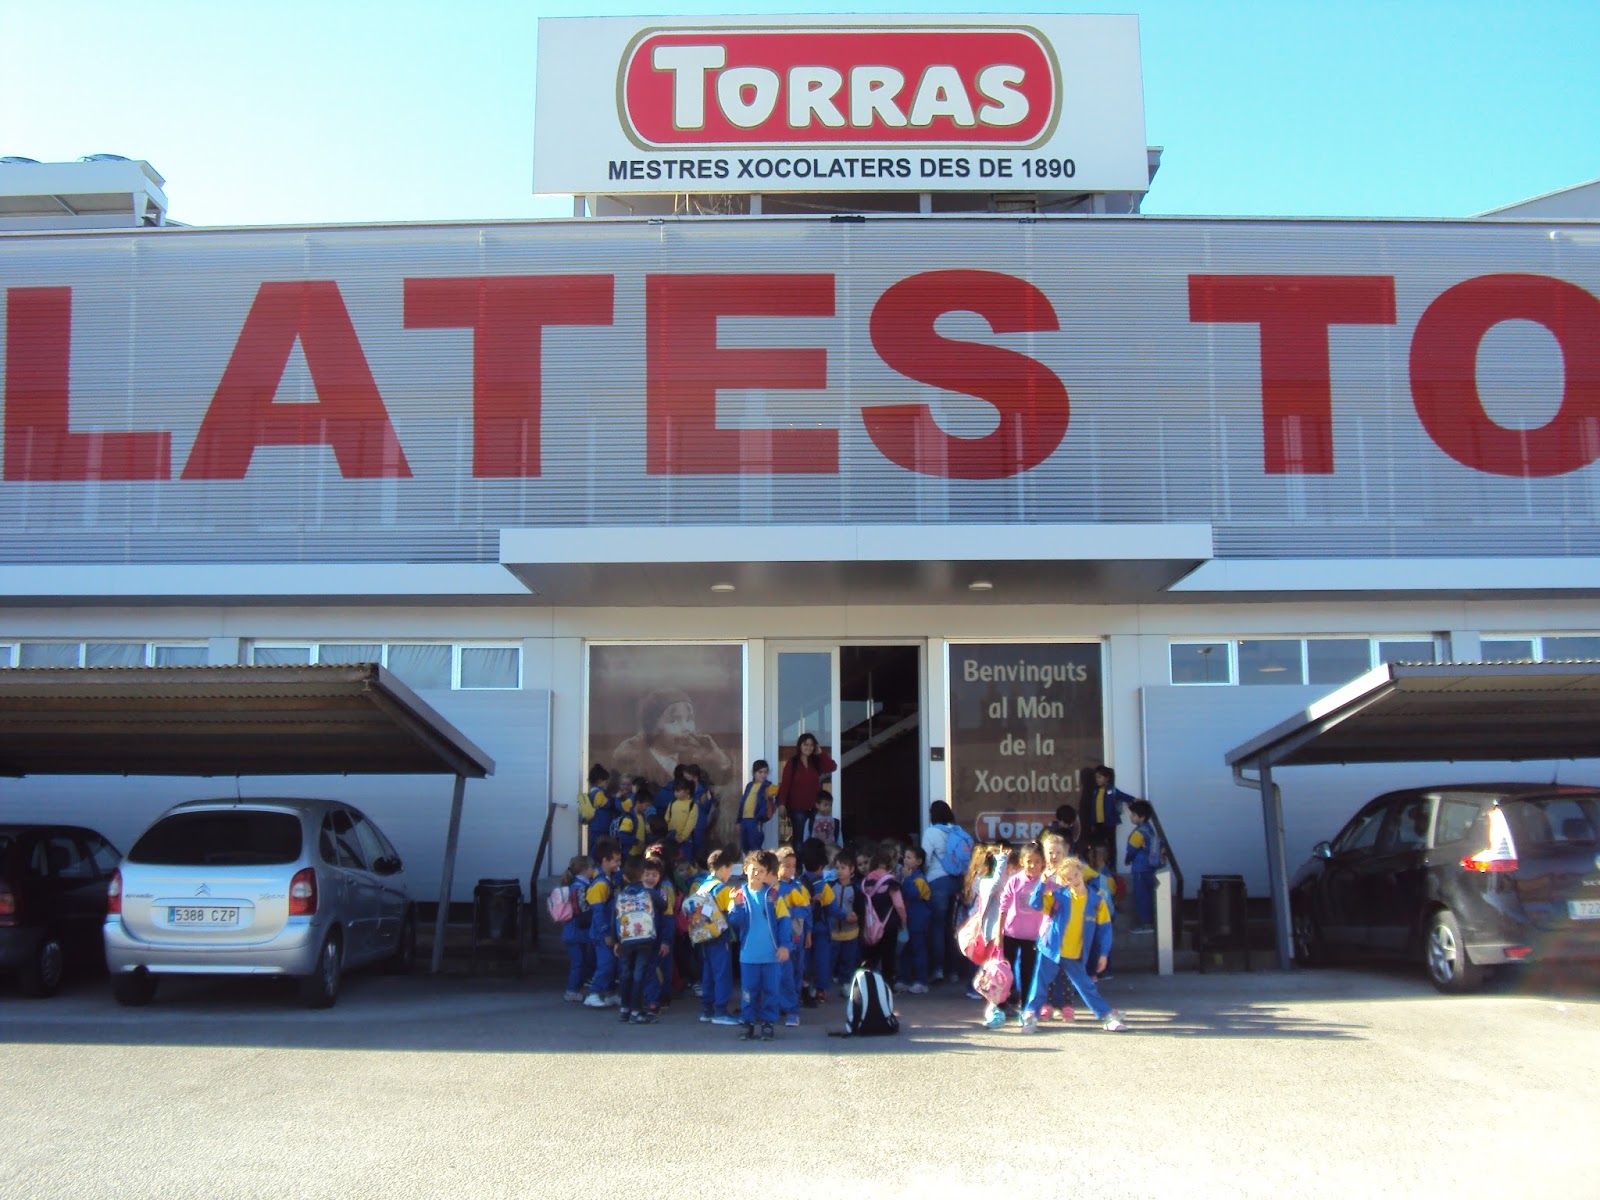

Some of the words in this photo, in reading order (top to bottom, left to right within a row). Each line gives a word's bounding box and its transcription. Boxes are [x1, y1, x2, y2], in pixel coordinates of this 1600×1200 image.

[651, 44, 1031, 130] TORRAS
[608, 160, 730, 180] MESTRES
[737, 158, 911, 179] XOCOLATERS
[920, 158, 970, 178] DES
[979, 158, 1013, 178] DE
[1021, 158, 1076, 178] 1890
[3, 269, 1071, 481] LATES
[1188, 273, 1600, 478] TO
[963, 659, 1088, 689] Benvinguts
[988, 696, 1008, 719] al
[1016, 695, 1064, 719] Món
[999, 733, 1026, 756] de
[1035, 733, 1055, 756] la
[974, 769, 1081, 793] Xocolata!
[983, 816, 1052, 839] TORR
[174, 909, 204, 922] 5388
[211, 909, 237, 923] CZP
